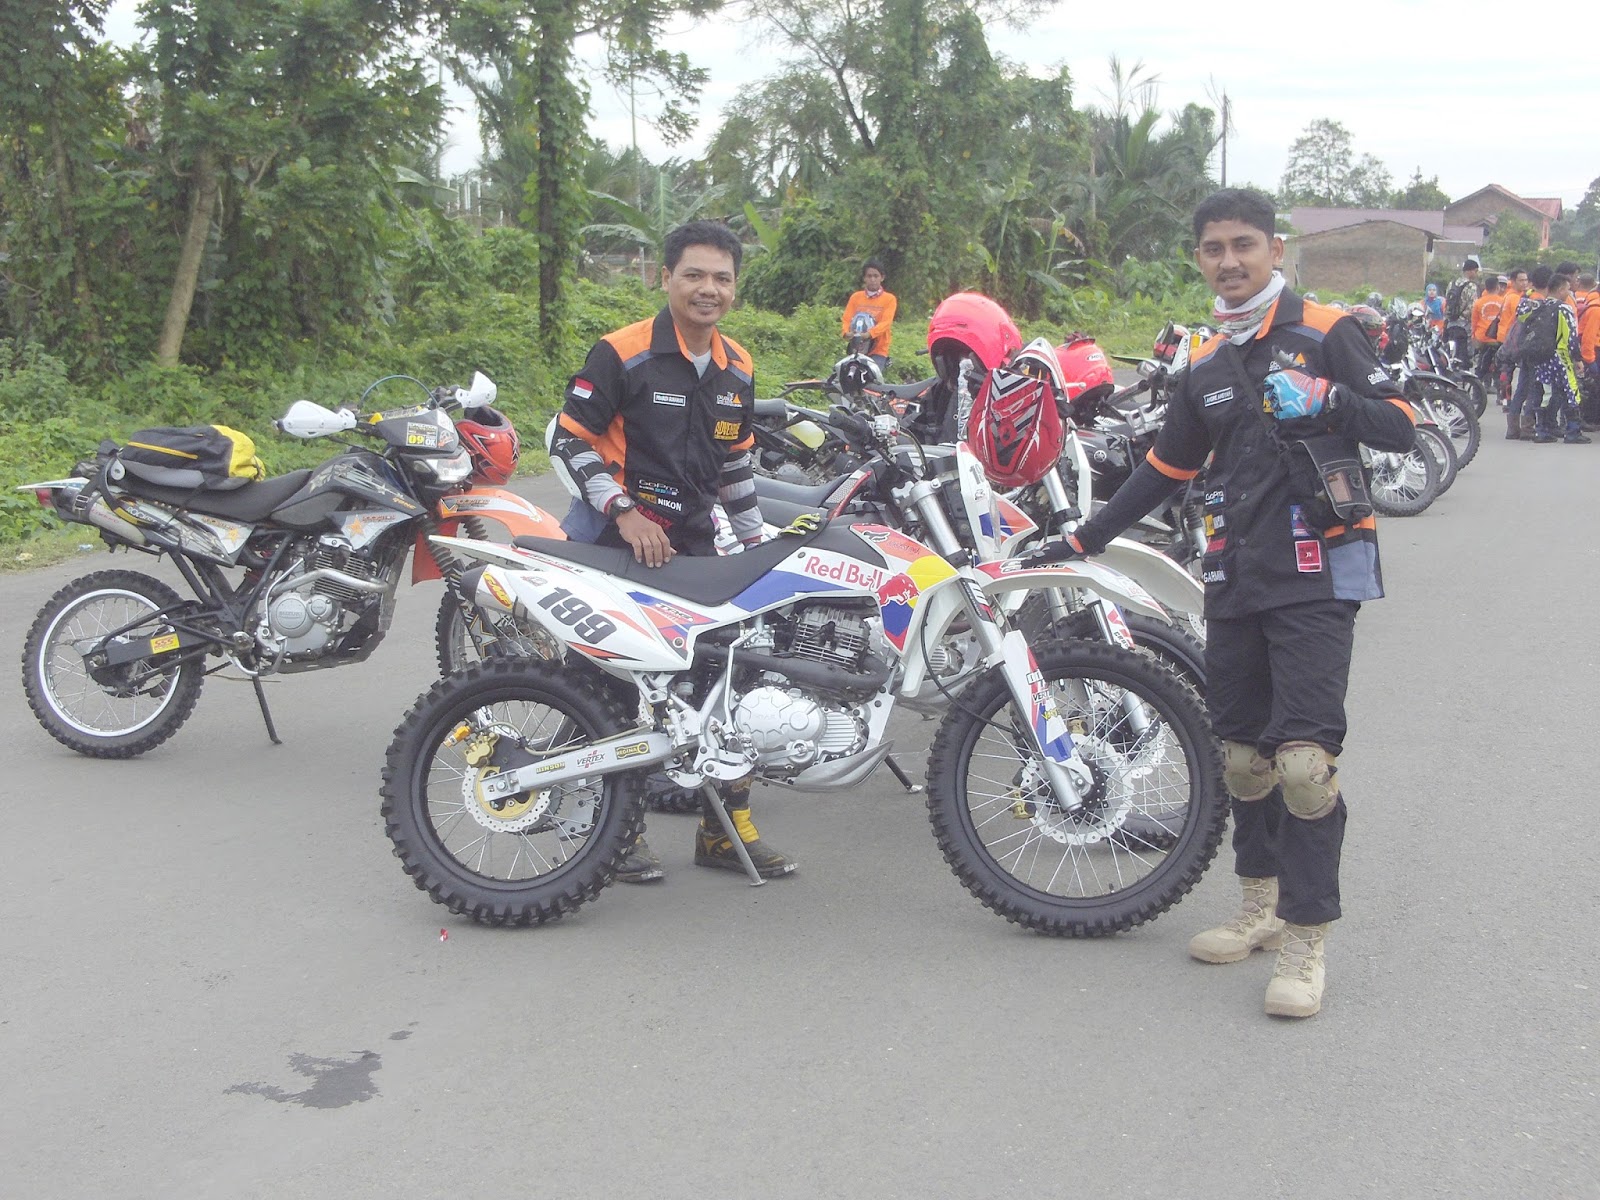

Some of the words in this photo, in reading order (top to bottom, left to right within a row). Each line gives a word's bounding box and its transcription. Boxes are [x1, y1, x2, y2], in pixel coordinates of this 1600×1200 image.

[639, 479, 680, 493] GoPro
[1205, 490, 1225, 501] GoPro
[657, 498, 682, 512] NIKON
[804, 555, 845, 581] Red
[845, 563, 884, 590] Bull
[1203, 570, 1226, 583] GARMIN
[537, 586, 618, 645] 199
[616, 746, 638, 757] REGINA
[576, 752, 605, 766] VERTEX
